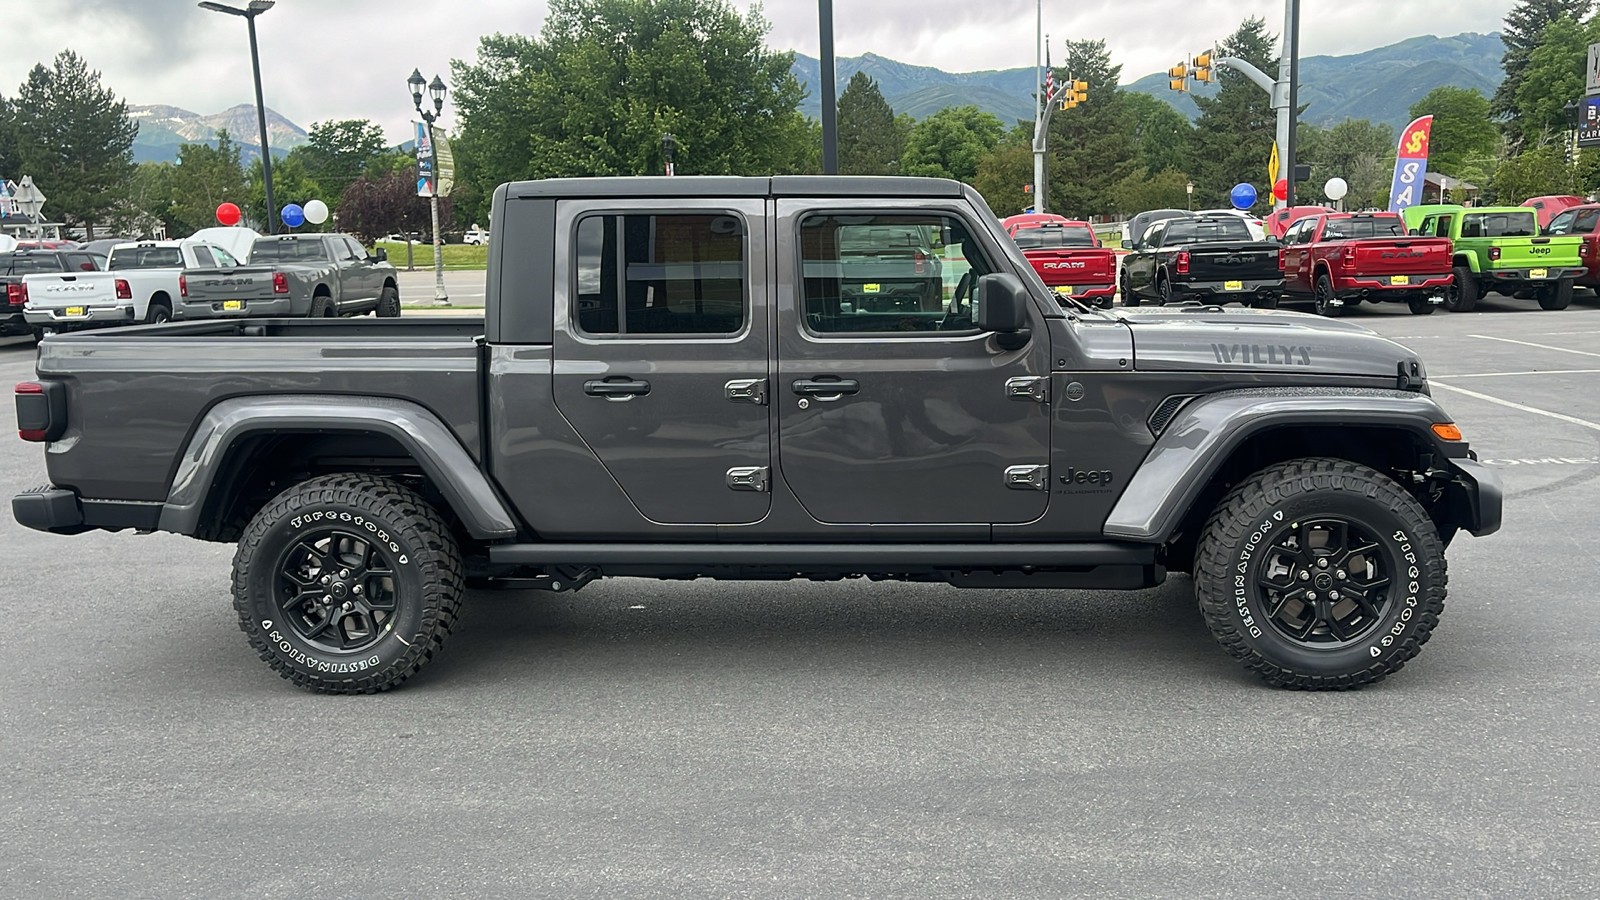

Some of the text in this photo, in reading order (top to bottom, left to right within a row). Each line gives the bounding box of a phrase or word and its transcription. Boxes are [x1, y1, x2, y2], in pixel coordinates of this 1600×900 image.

[1529, 247, 1551, 255] Jeep
[1043, 261, 1086, 269] RAM
[1213, 256, 1256, 264] RAM
[46, 282, 95, 292] RAM
[205, 278, 253, 286] RAM
[1210, 343, 1312, 366] WILLYS
[1060, 466, 1114, 487] Jeep
[1234, 520, 1273, 639] DESTINATION
[269, 630, 380, 673] DESTINATION
